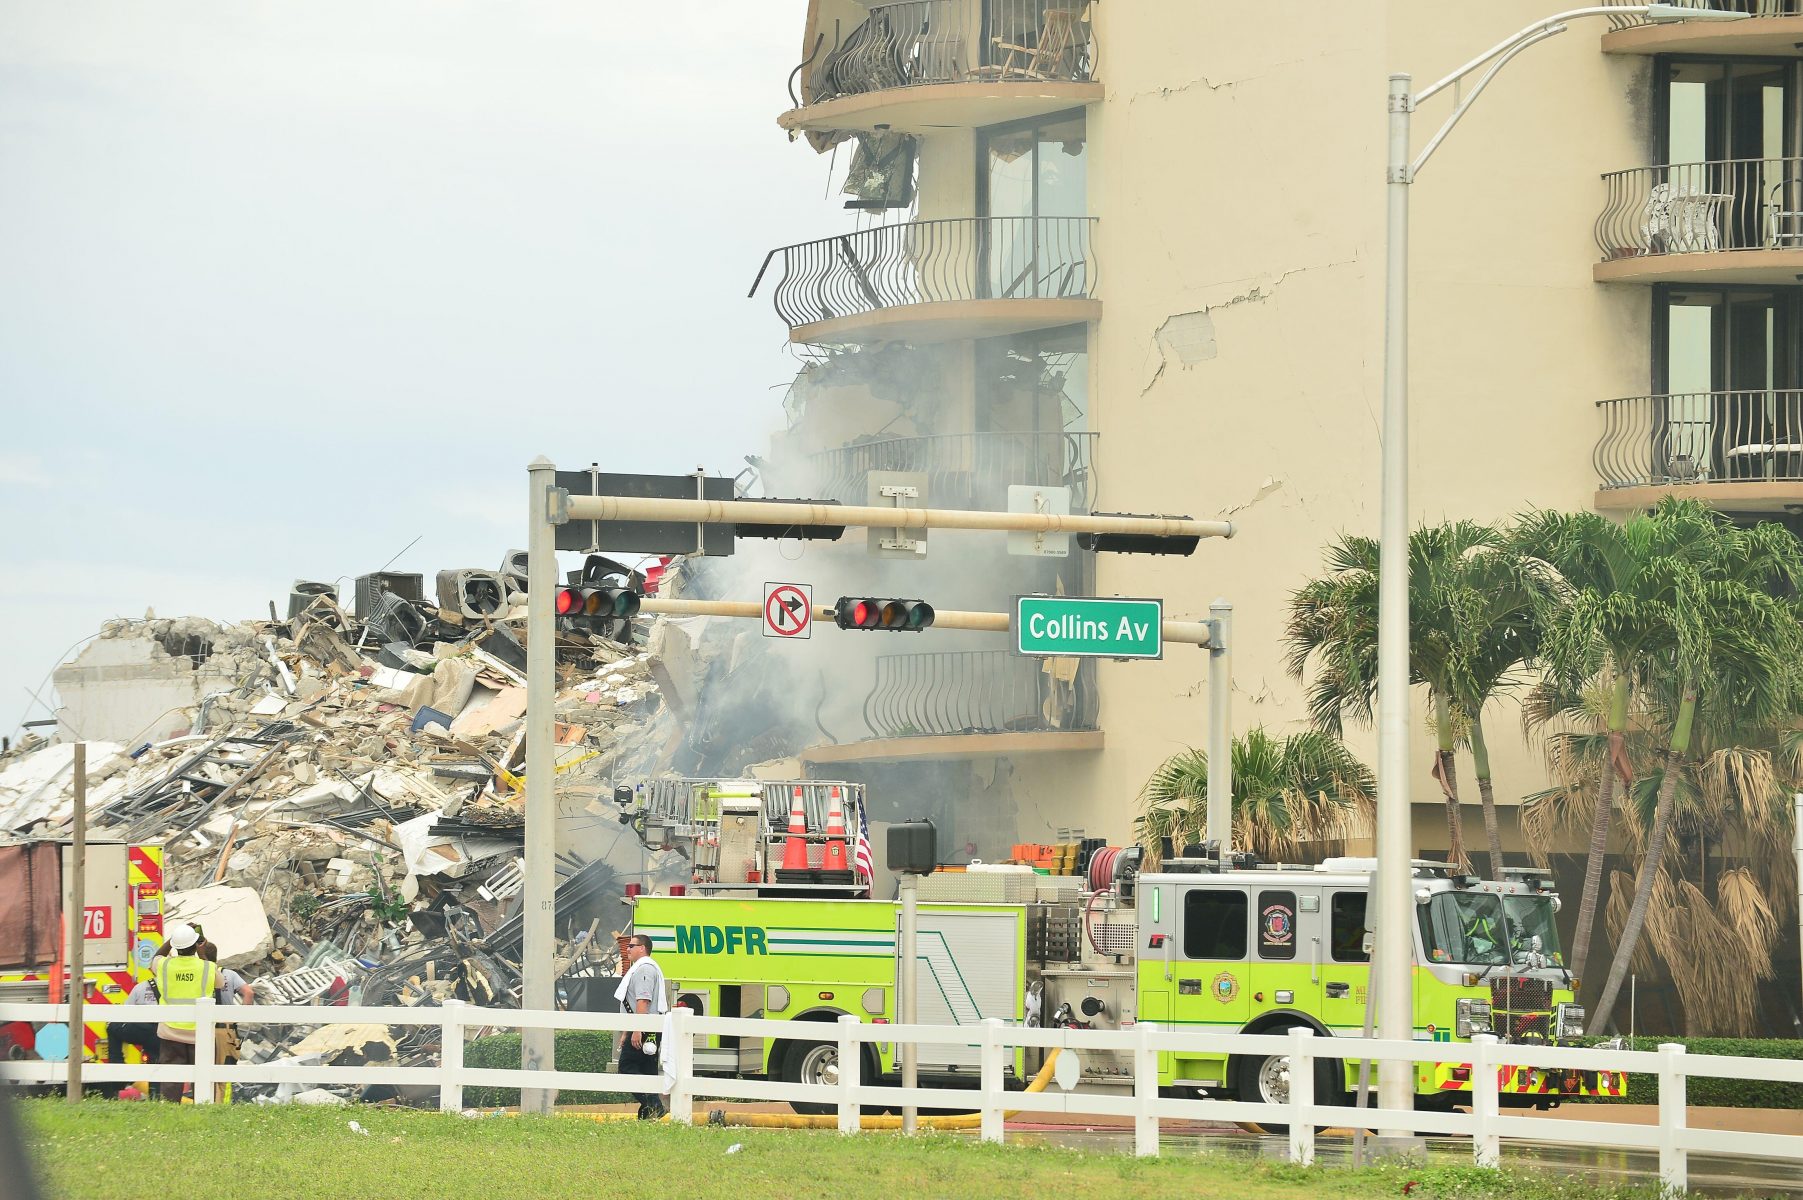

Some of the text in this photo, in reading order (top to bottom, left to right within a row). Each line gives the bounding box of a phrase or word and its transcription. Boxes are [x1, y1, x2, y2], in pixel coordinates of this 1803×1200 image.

[1029, 612, 1149, 641] Collins Av
[83, 910, 105, 936] 76
[675, 925, 768, 956] MDFR
[175, 973, 194, 982] WASD
